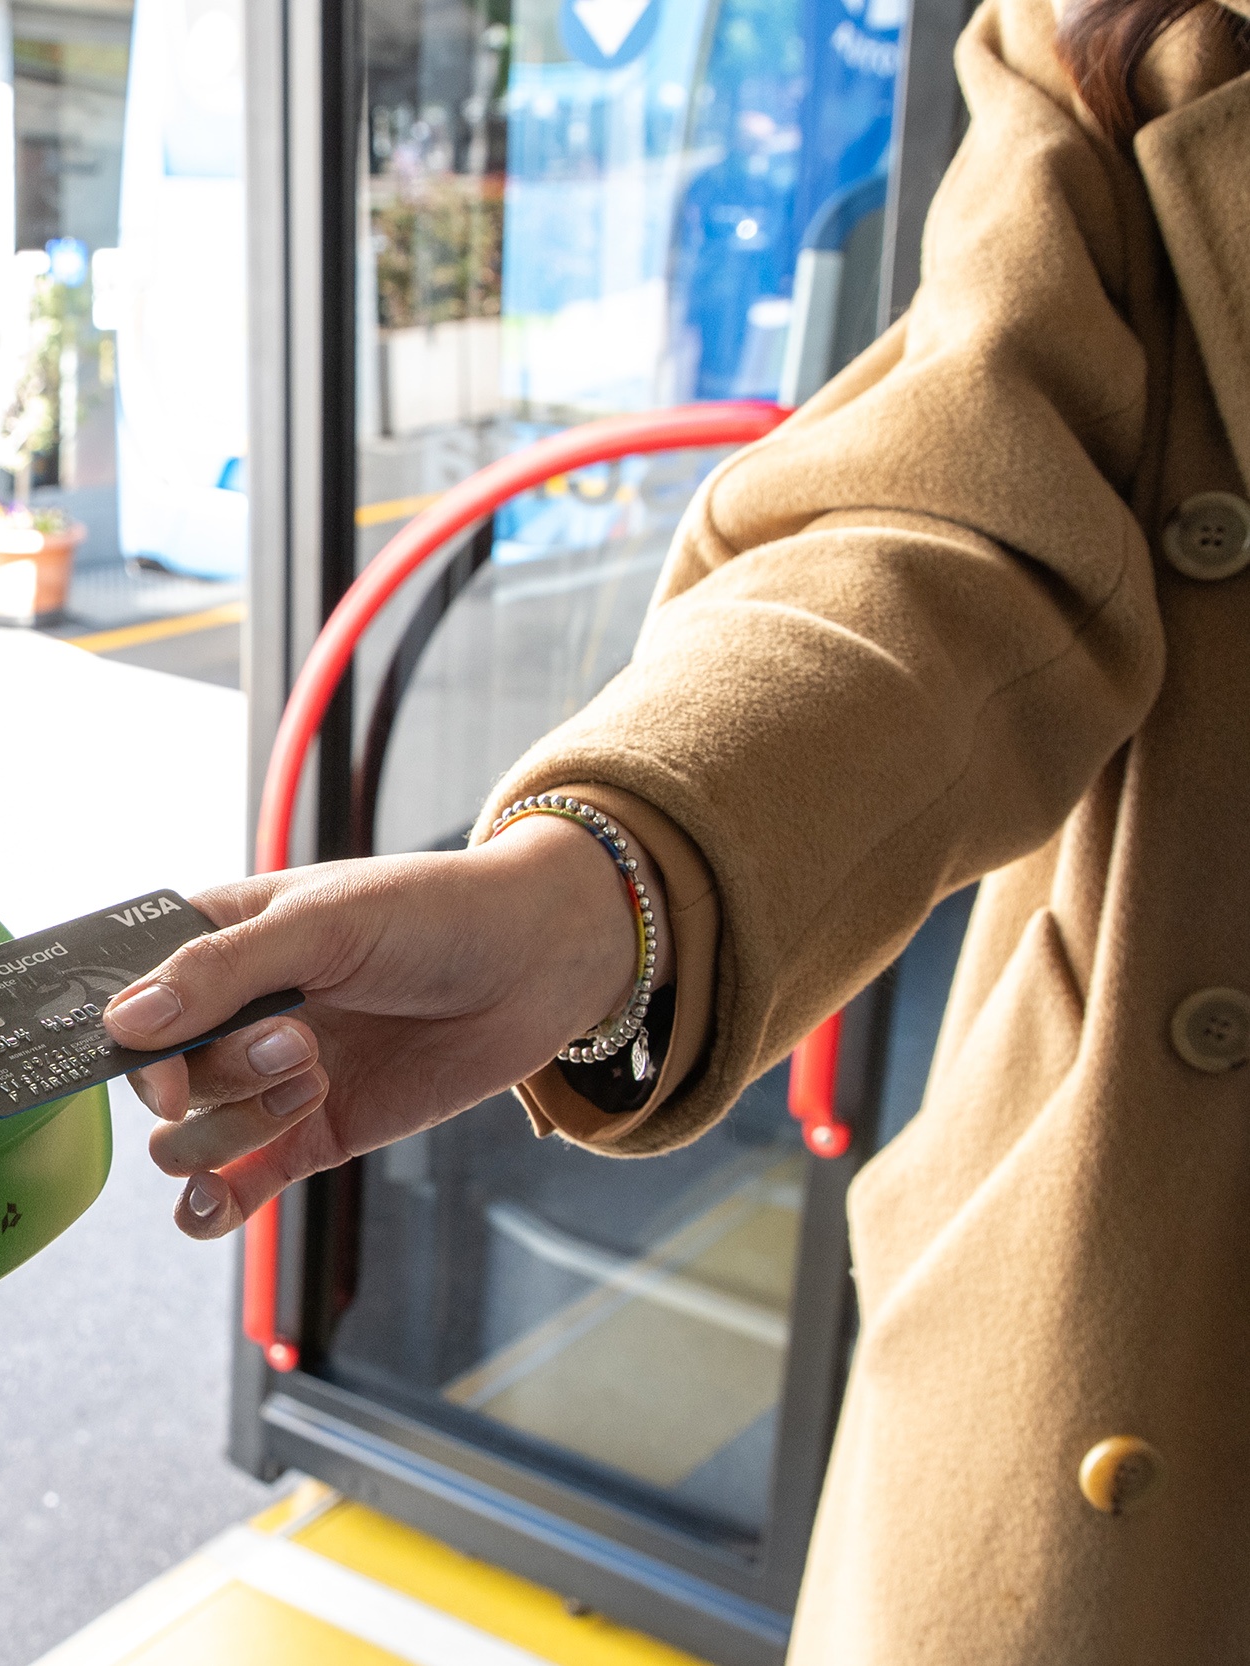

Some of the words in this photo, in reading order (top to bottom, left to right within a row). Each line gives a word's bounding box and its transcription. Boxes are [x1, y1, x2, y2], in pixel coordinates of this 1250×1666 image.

[104, 896, 183, 928] VISA
[8, 1043, 47, 1060] MONTH/YEAR
[48, 1045, 111, 1075] EUROPE
[74, 1044, 91, 1053] END
[8, 1090, 19, 1103] F
[29, 1065, 92, 1096] FARINA
